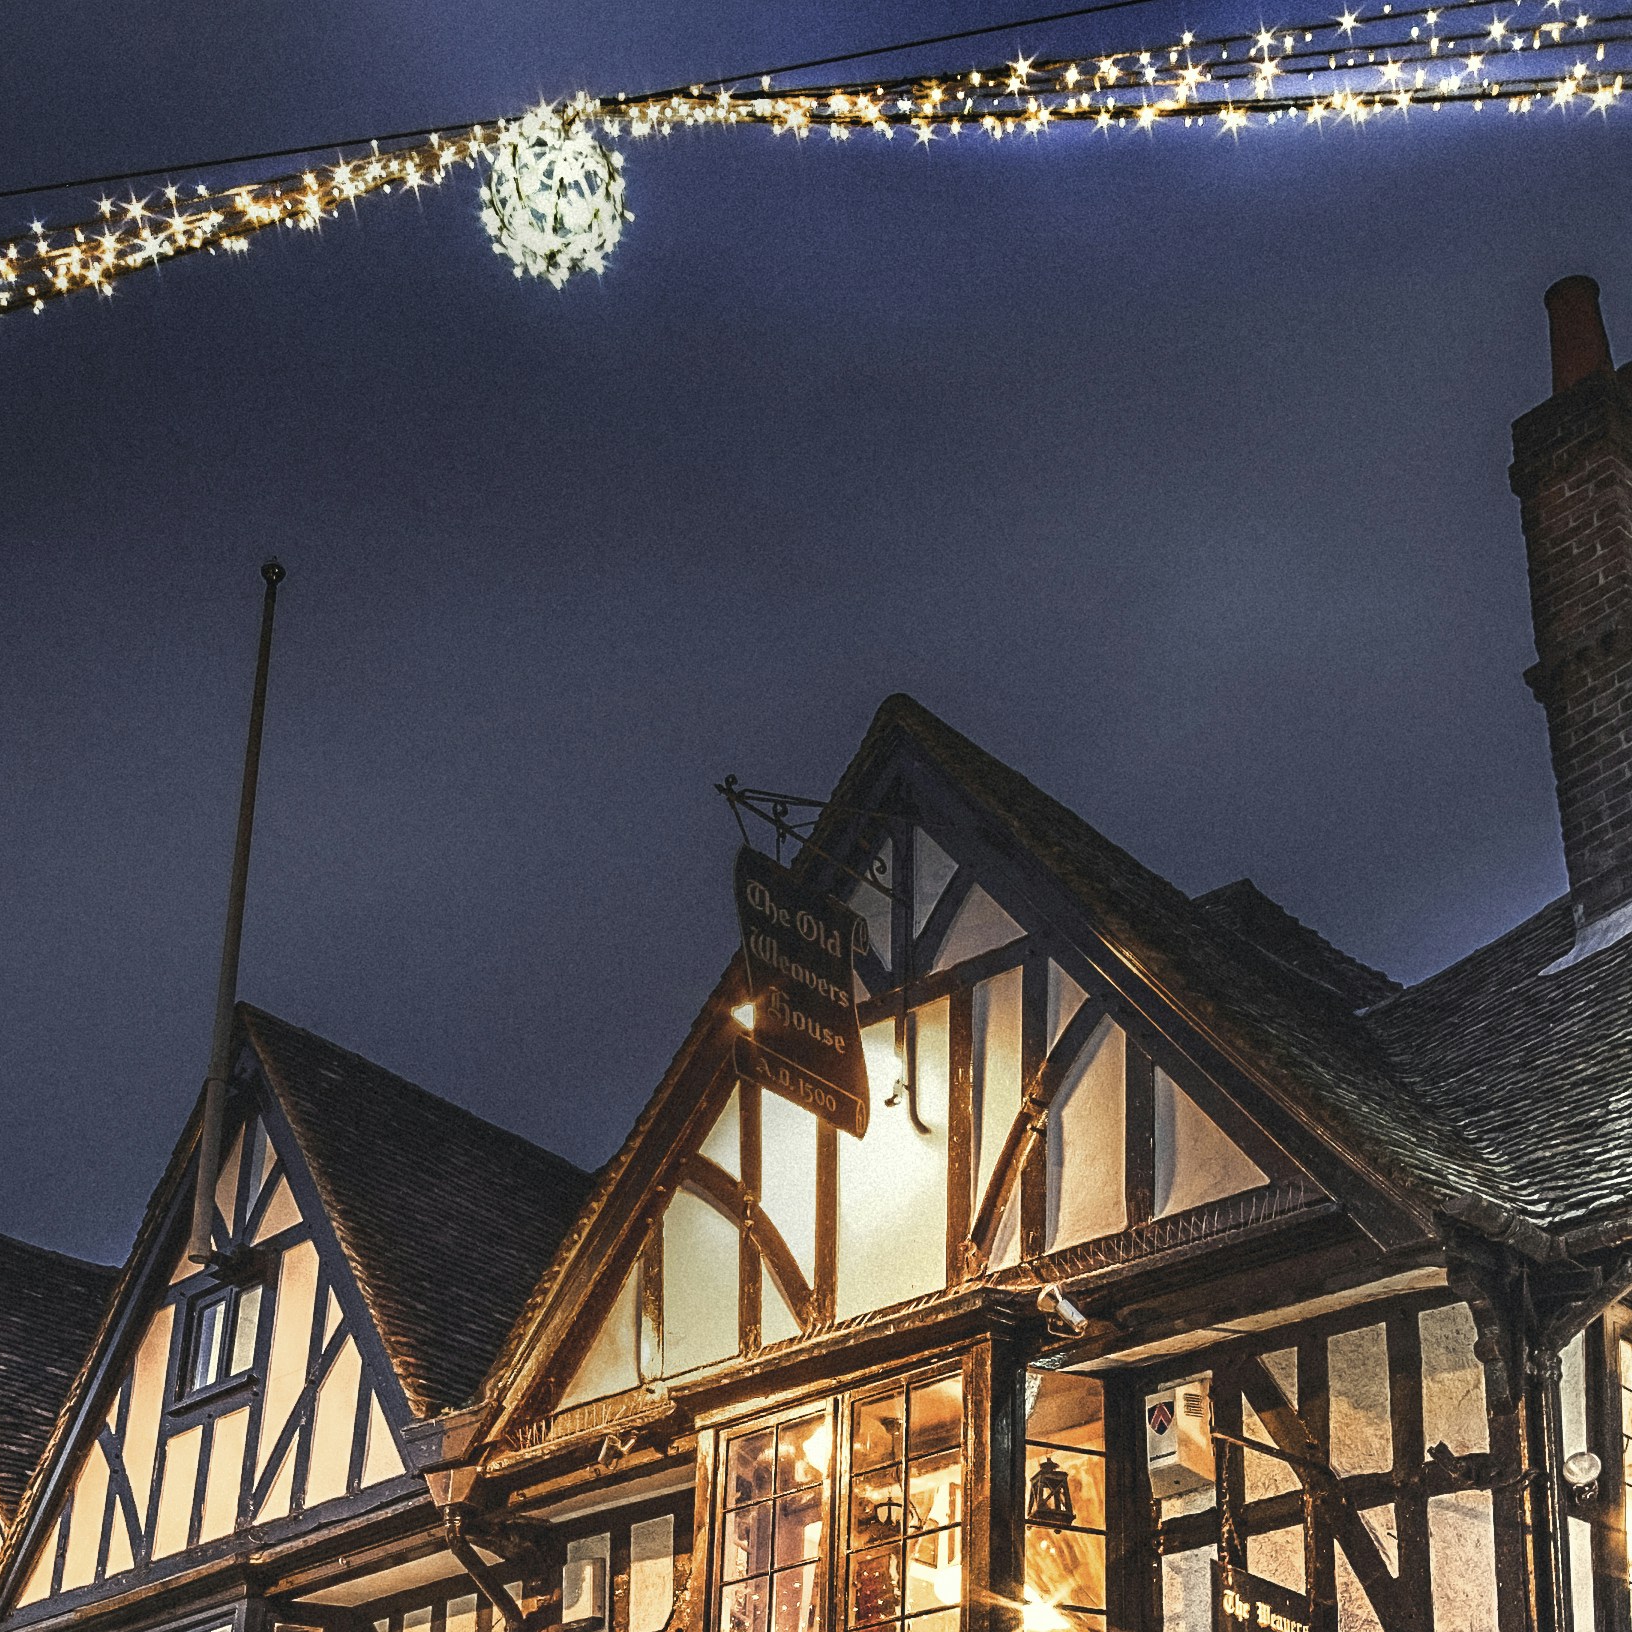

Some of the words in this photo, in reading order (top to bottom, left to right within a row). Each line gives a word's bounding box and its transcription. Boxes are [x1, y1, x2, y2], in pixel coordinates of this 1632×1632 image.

[747, 880, 790, 926] The
[797, 911, 841, 957] Old
[750, 926, 850, 1008] Weavers
[769, 986, 845, 1053] House
[1223, 1589, 1250, 1622] The
